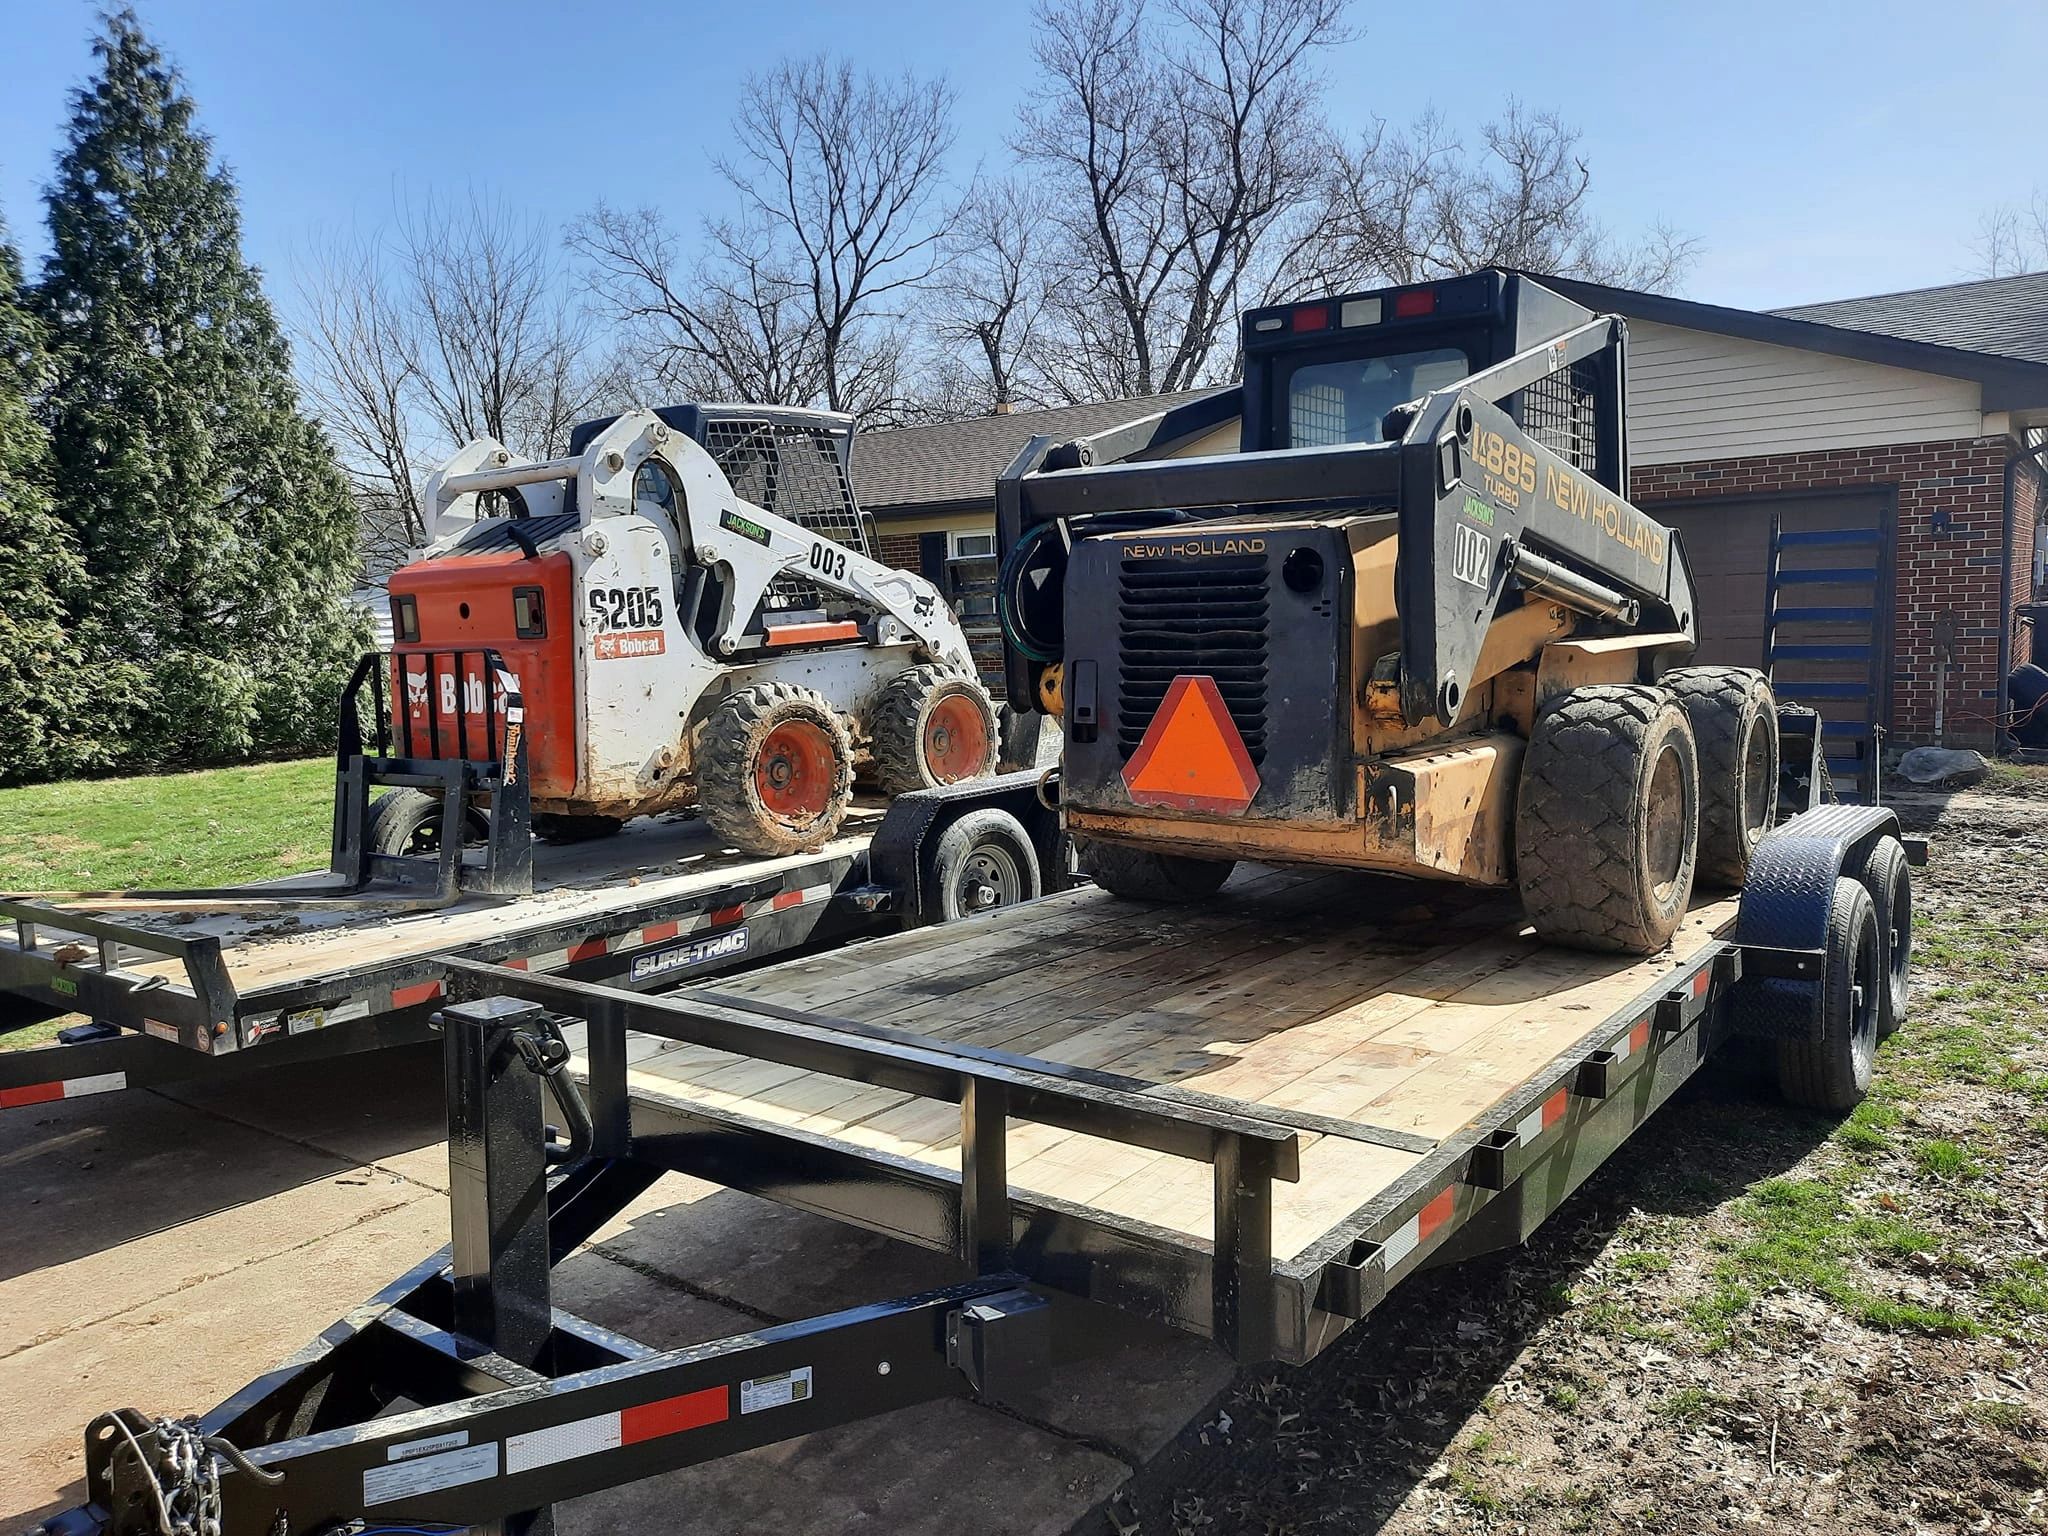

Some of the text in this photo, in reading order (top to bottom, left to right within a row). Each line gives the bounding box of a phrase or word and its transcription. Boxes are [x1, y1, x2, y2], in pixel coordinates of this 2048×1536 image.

[1483, 474, 1521, 508] TURBO
[726, 514, 766, 539] JACKSON'S
[1545, 464, 1589, 520] NEW
[1592, 498, 1665, 565] HOLLAND
[809, 542, 846, 581] 003
[1123, 538, 1266, 559] NEW HOLLAND
[1455, 525, 1489, 588] 002
[589, 586, 664, 632] S205
[619, 637, 660, 655] Bobcat
[440, 673, 521, 715] Boba
[634, 932, 746, 976] SURE-TRAC
